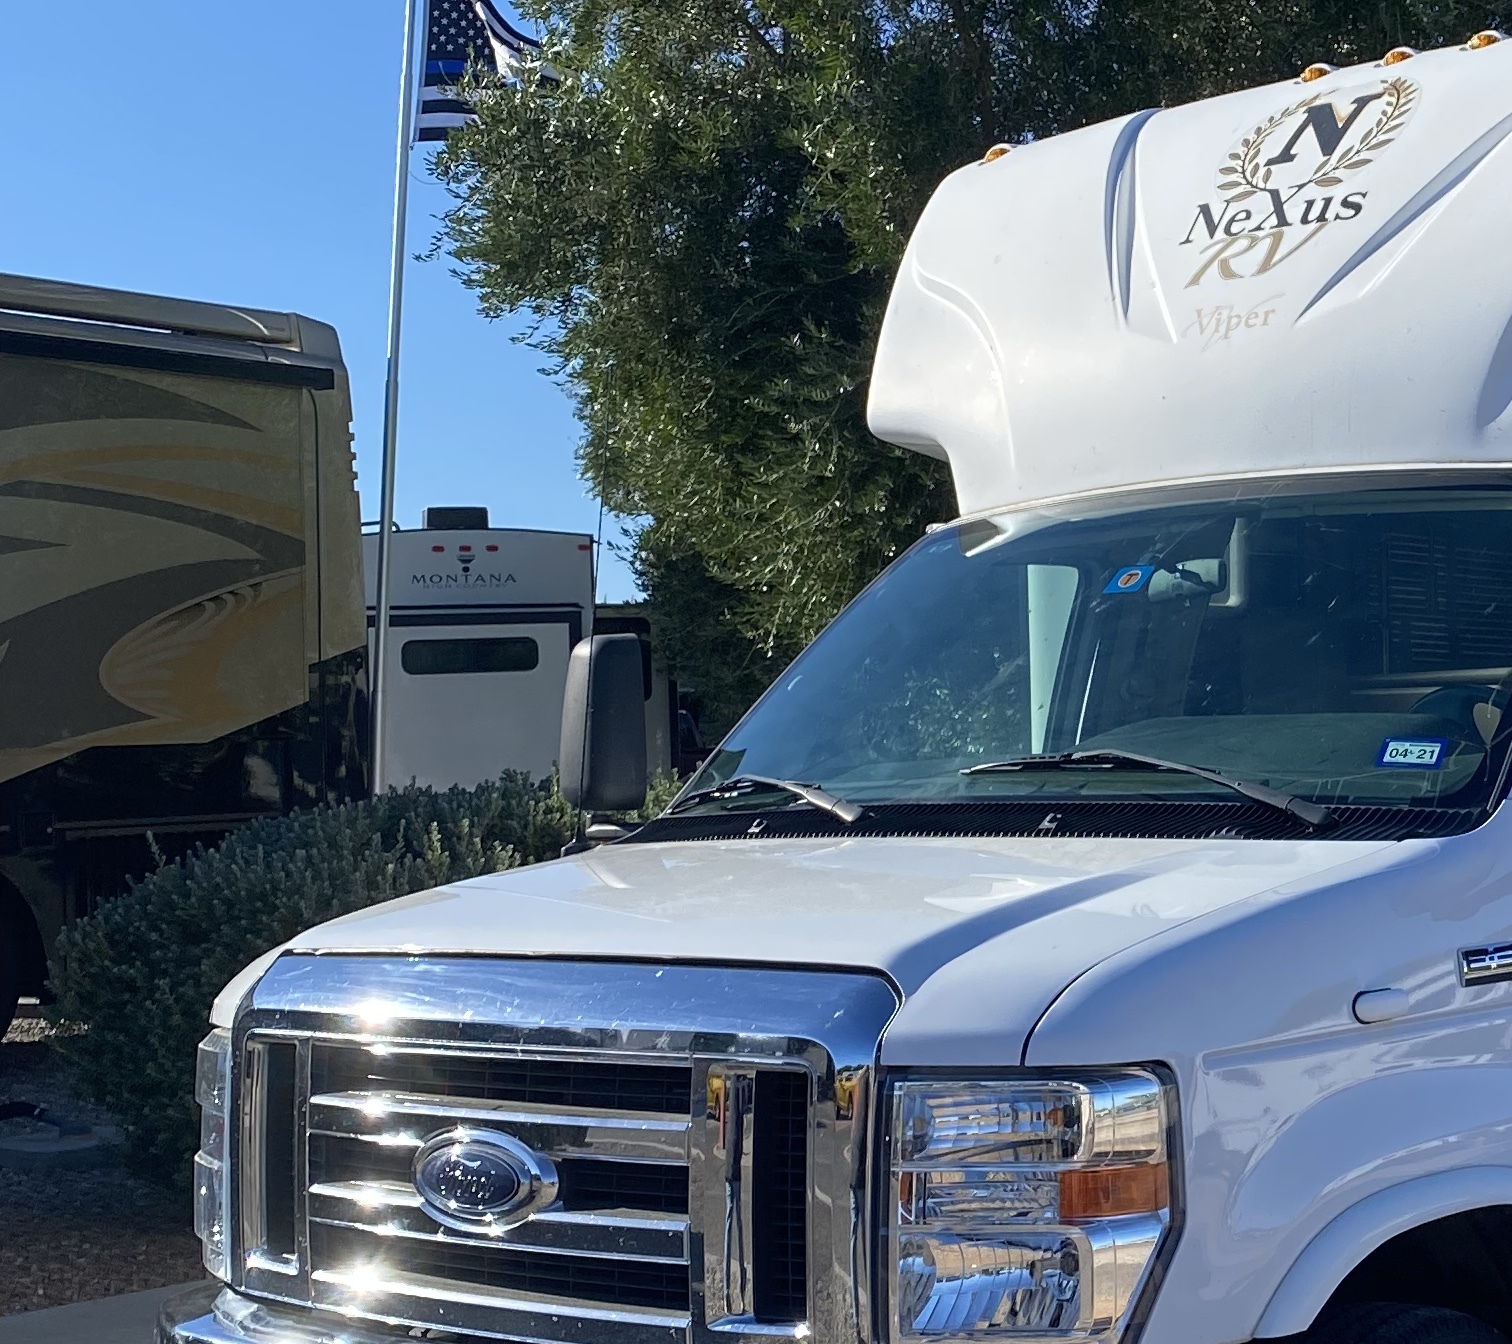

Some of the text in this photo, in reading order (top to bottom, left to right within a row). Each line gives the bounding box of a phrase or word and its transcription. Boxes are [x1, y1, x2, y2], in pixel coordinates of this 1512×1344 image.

[1263, 91, 1389, 168] N
[1178, 187, 1370, 246] NeXus
[1183, 222, 1330, 290] RV
[1183, 300, 1277, 346] Viper
[411, 573, 518, 585] MONTANA
[1416, 748, 1436, 760] 21
